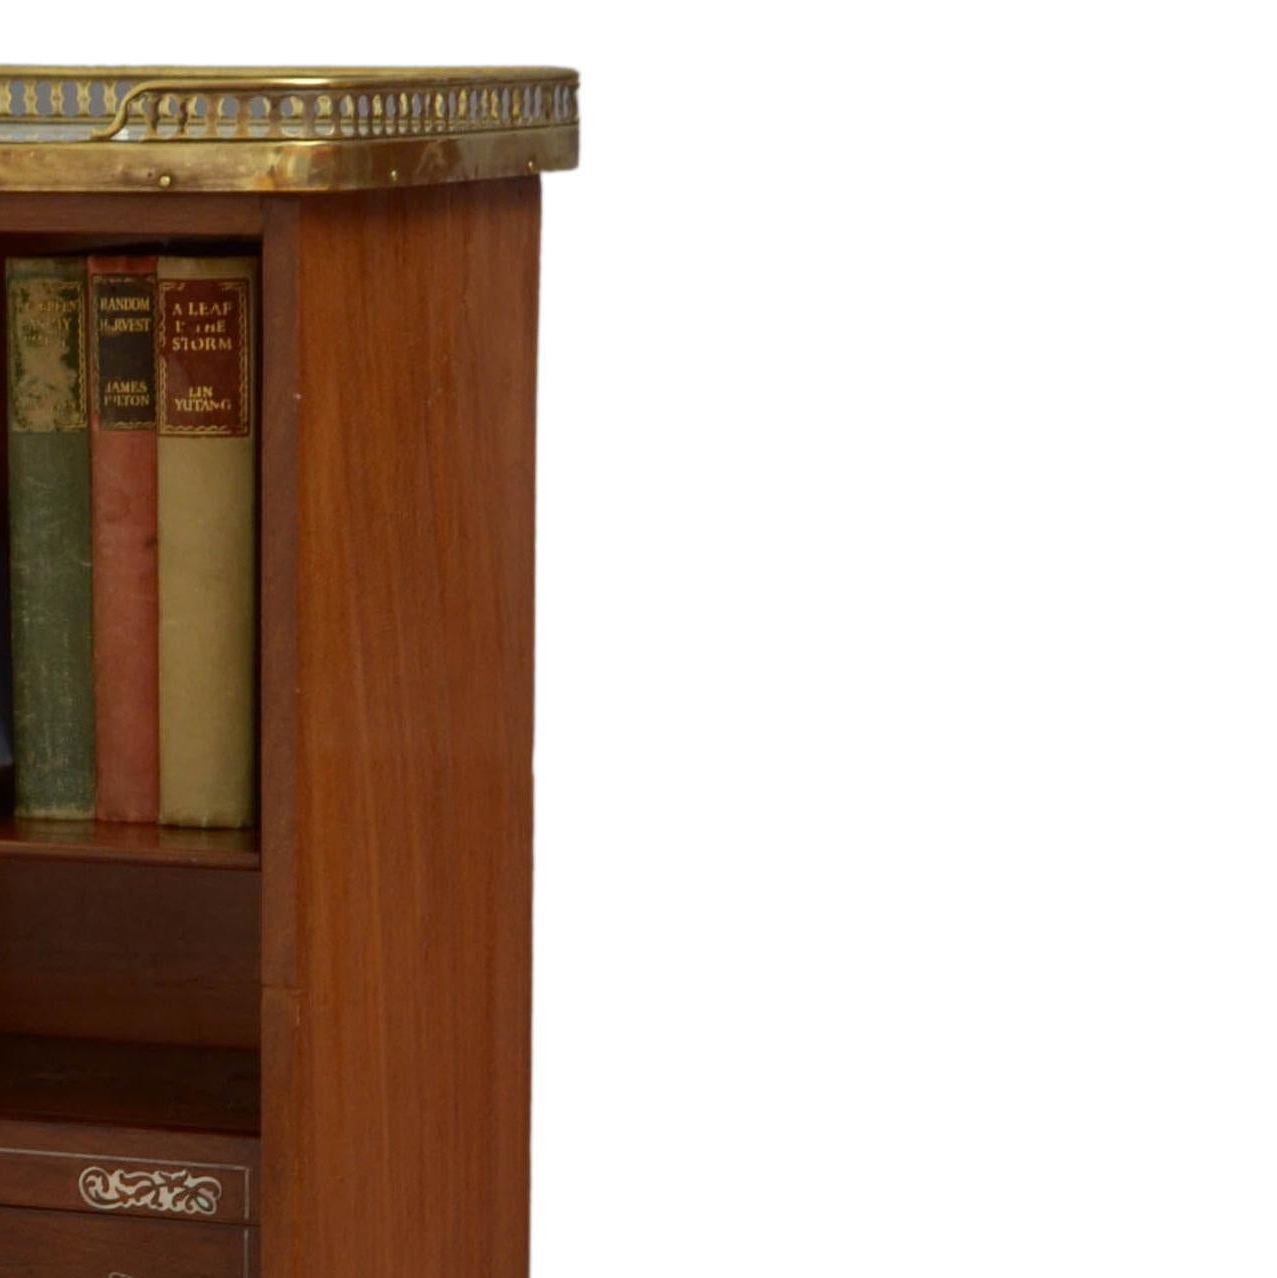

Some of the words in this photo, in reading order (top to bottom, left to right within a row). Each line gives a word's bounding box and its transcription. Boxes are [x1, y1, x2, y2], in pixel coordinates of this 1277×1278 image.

[100, 297, 150, 312] RANDOM
[172, 303, 183, 316] A
[188, 302, 233, 316] LEAF
[172, 336, 233, 350] STORM
[106, 380, 148, 393] JAMES
[188, 386, 213, 398] LIN
[175, 398, 232, 413] YUTANG
